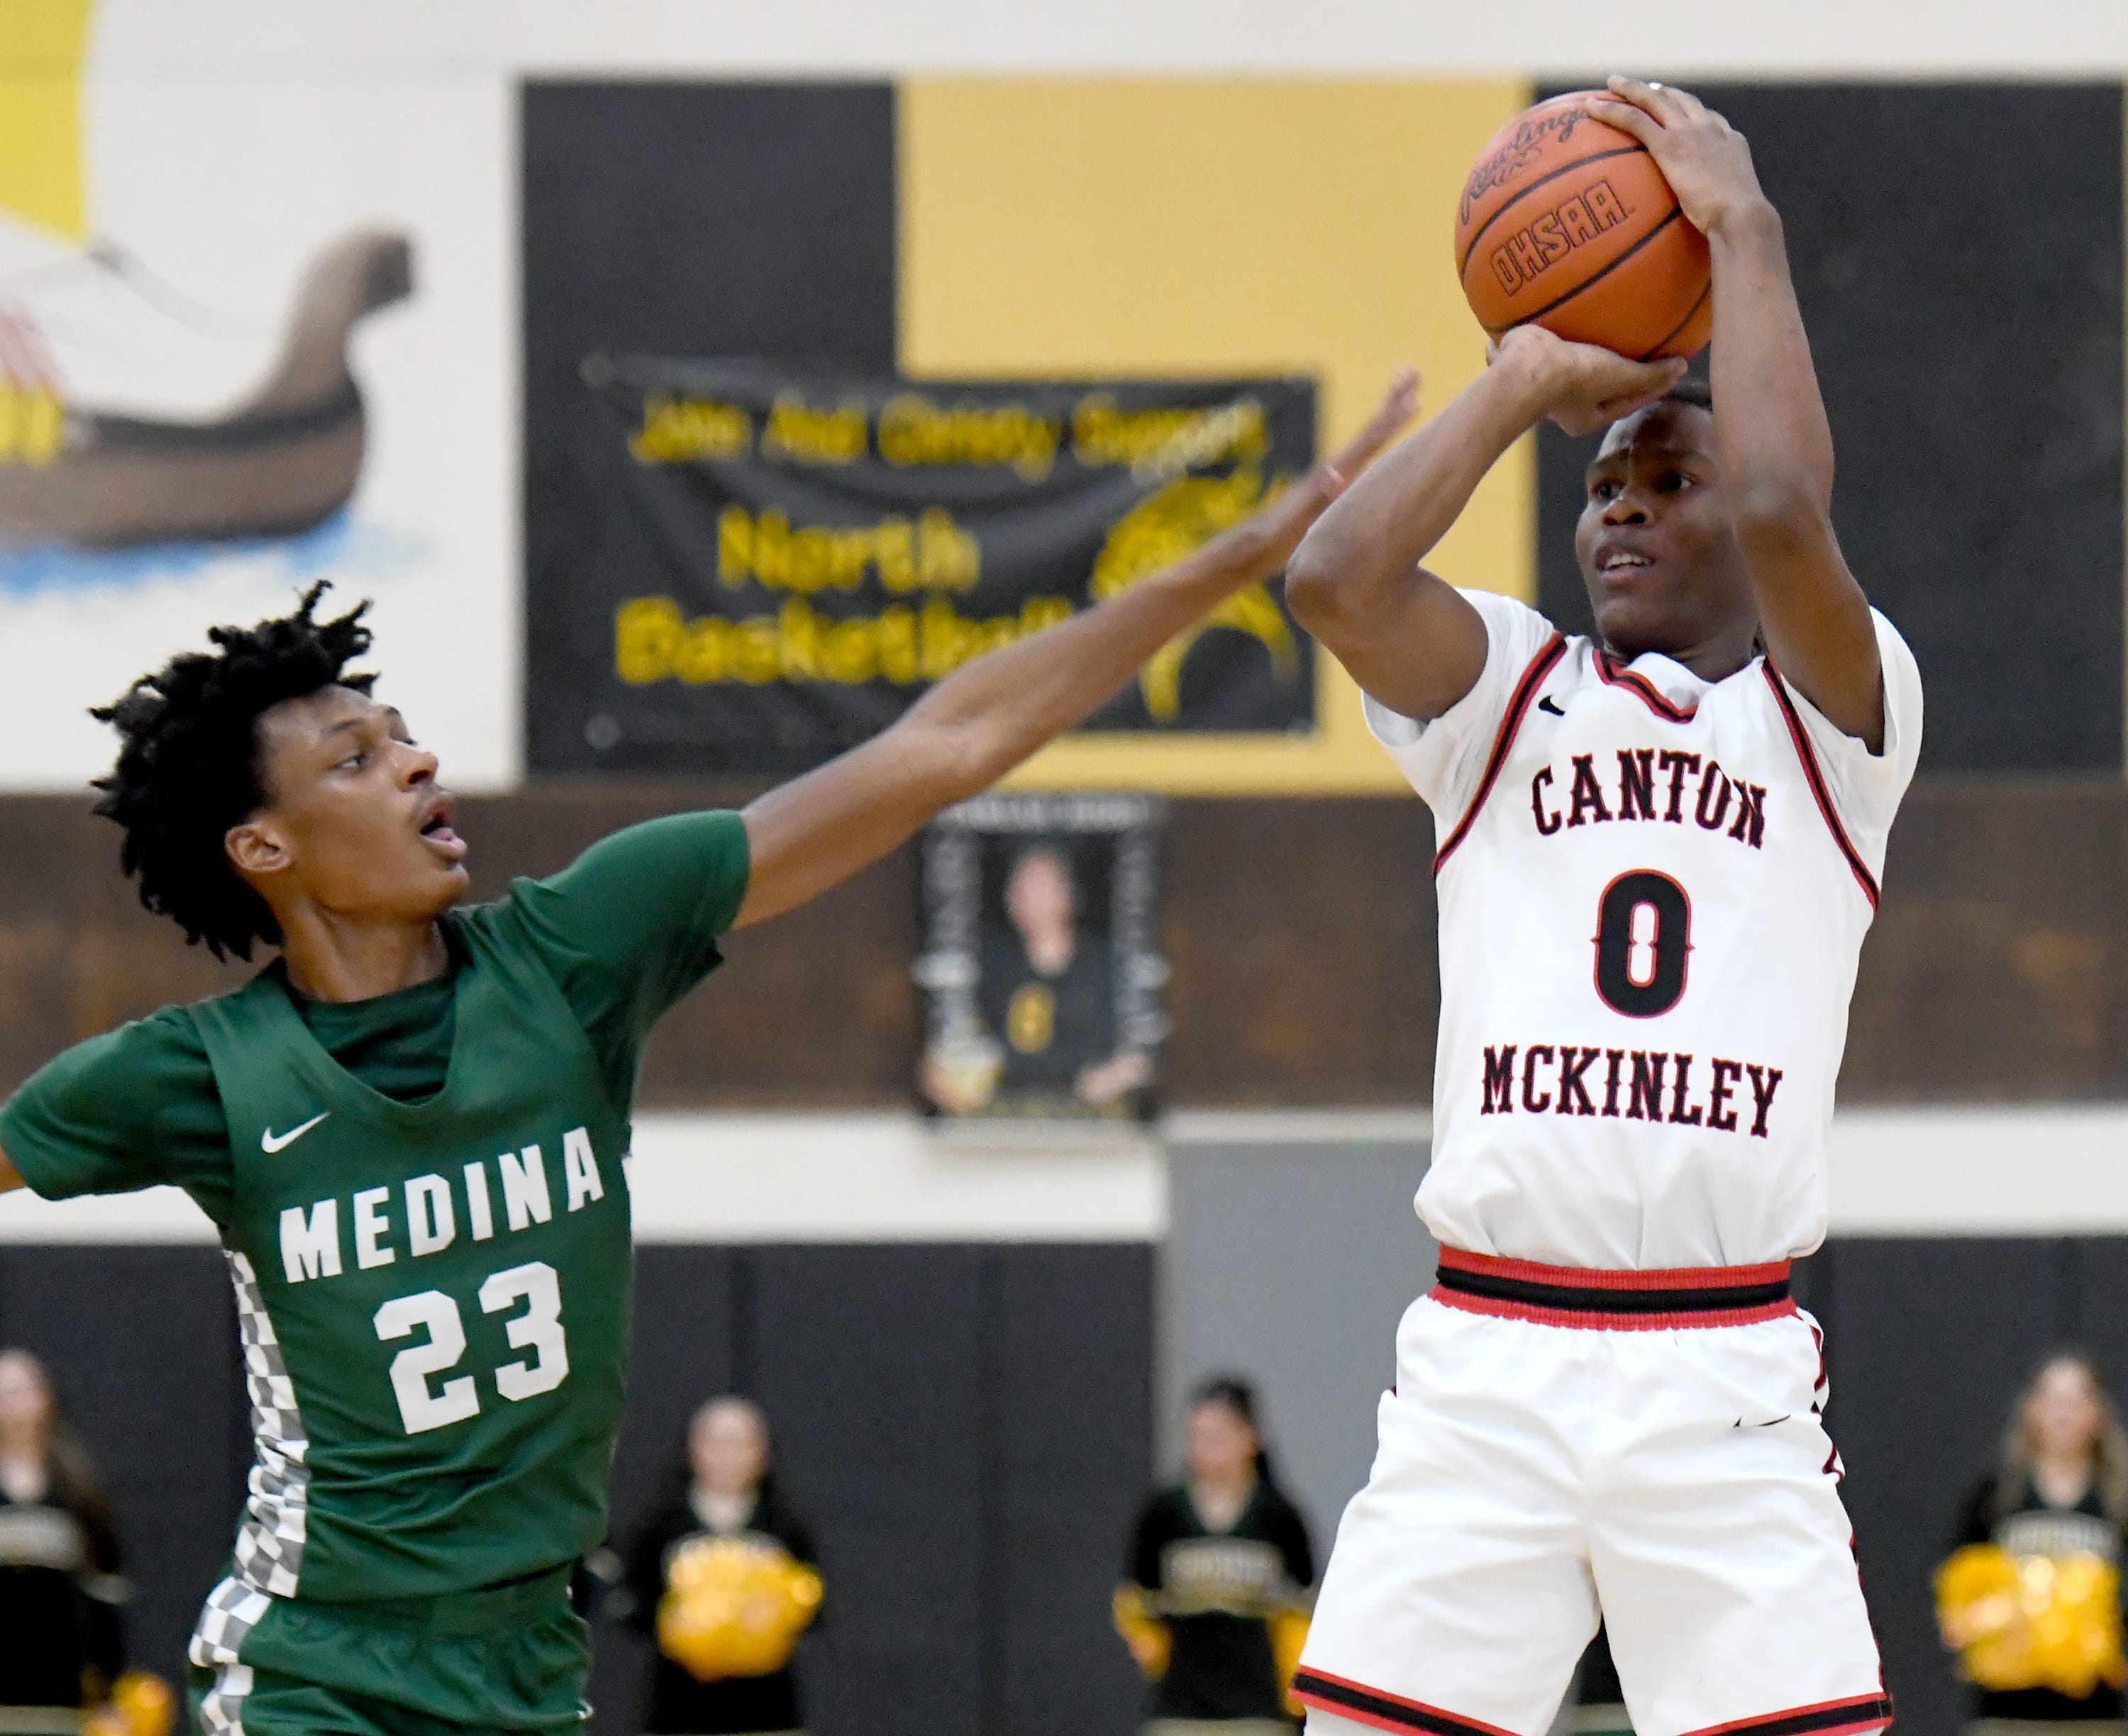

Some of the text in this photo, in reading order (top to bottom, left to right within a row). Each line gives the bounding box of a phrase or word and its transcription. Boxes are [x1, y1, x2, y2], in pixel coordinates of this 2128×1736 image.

[1490, 179, 1629, 298] OHSAA
[718, 505, 980, 592] North
[1531, 748, 1767, 850] CANTON
[1590, 869, 1695, 1019] 0
[1480, 1044, 1783, 1138] MCKINLEY
[279, 1126, 604, 1284] MEDINA
[372, 1261, 569, 1435] 23
